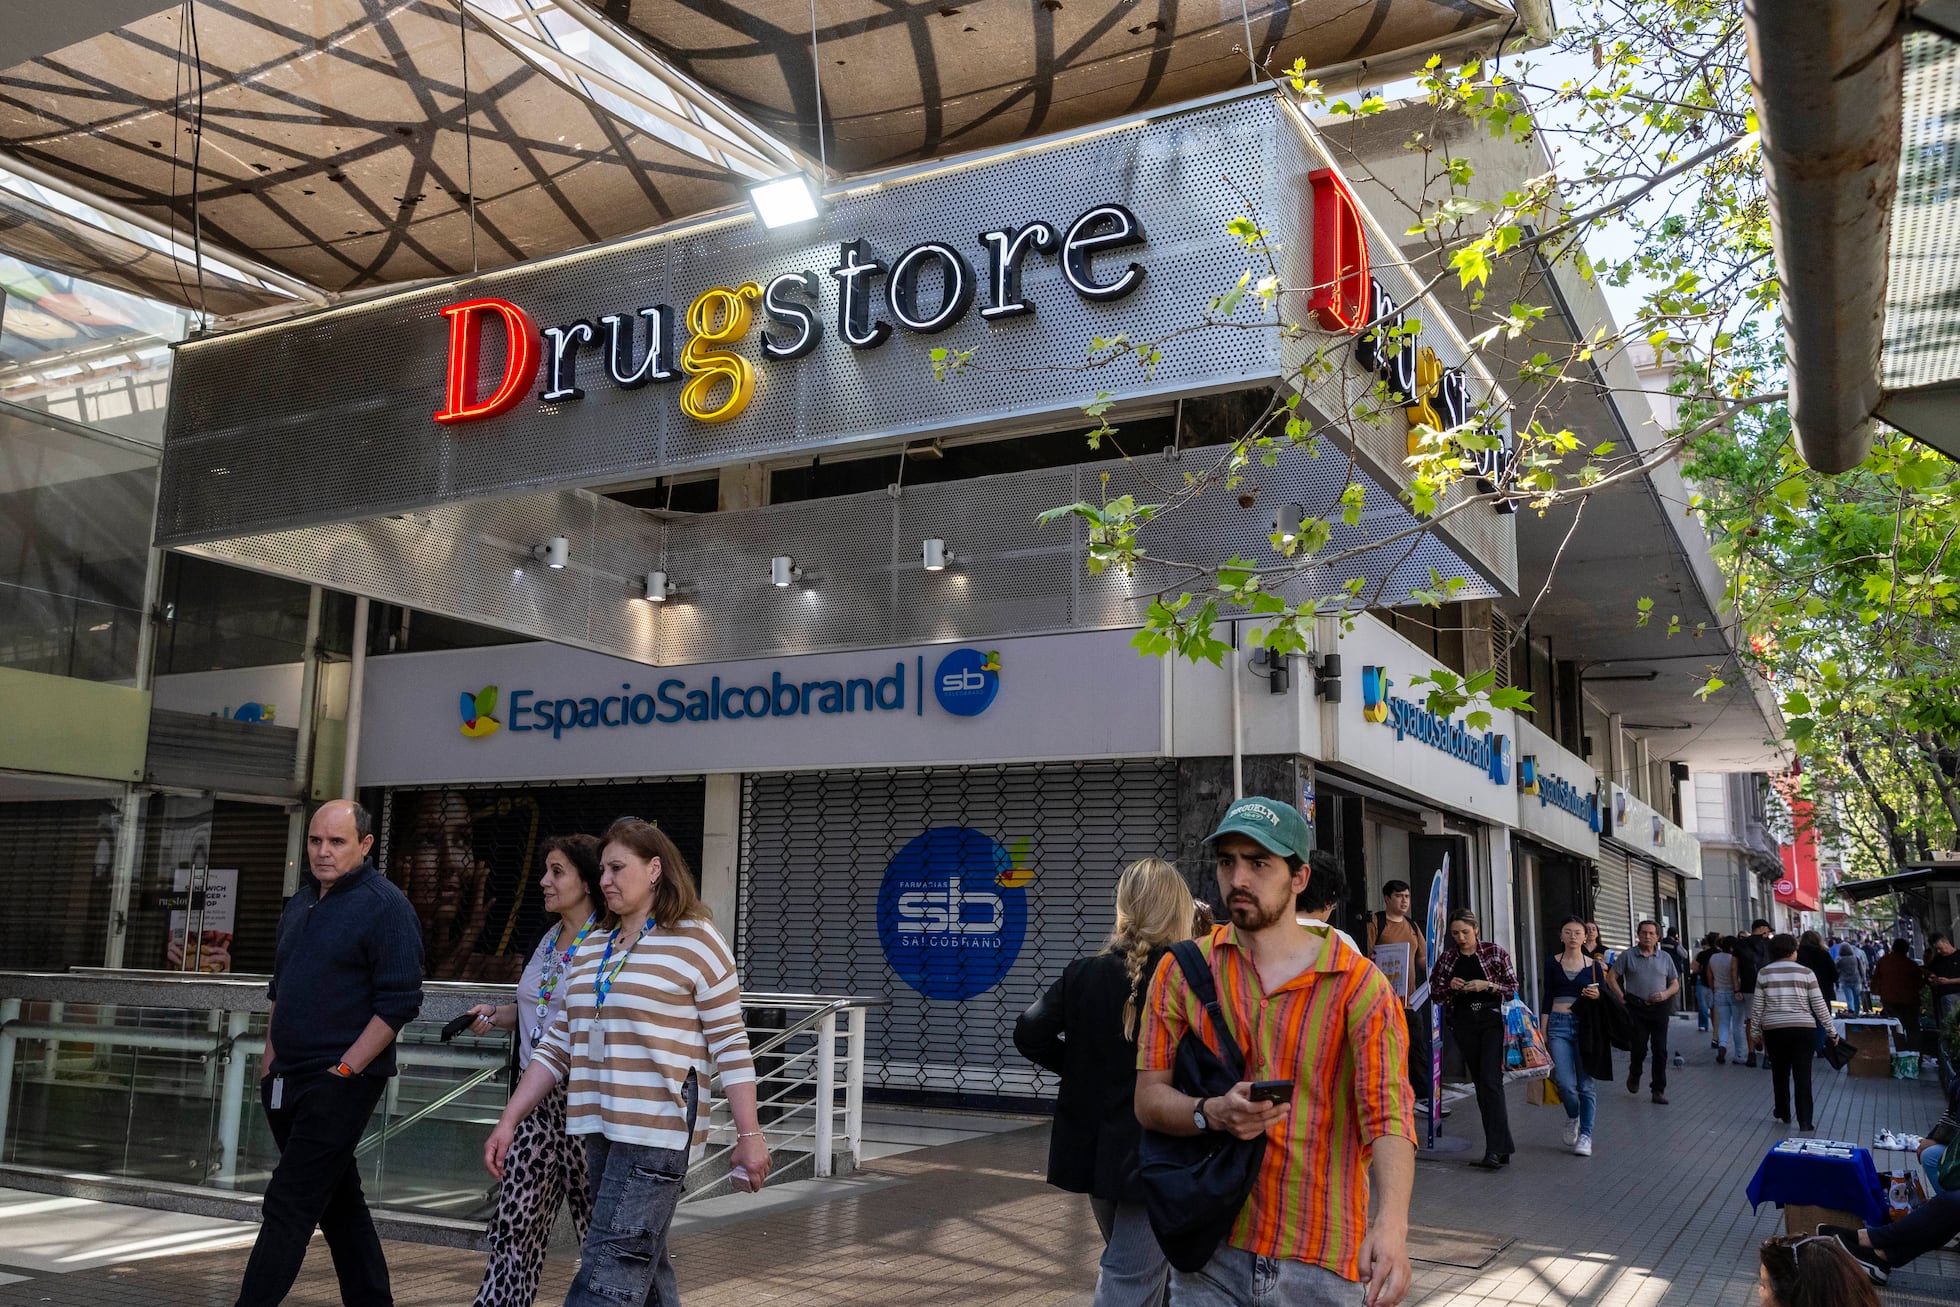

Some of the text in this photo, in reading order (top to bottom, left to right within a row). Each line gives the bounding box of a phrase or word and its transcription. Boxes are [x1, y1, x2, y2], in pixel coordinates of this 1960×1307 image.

[434, 204, 1147, 424] Drugstore
[509, 662, 905, 739] EspacioSalcobrand
[943, 668, 984, 691] sb
[1537, 772, 1591, 822] spacioSalcobrand
[898, 876, 1004, 935] sb
